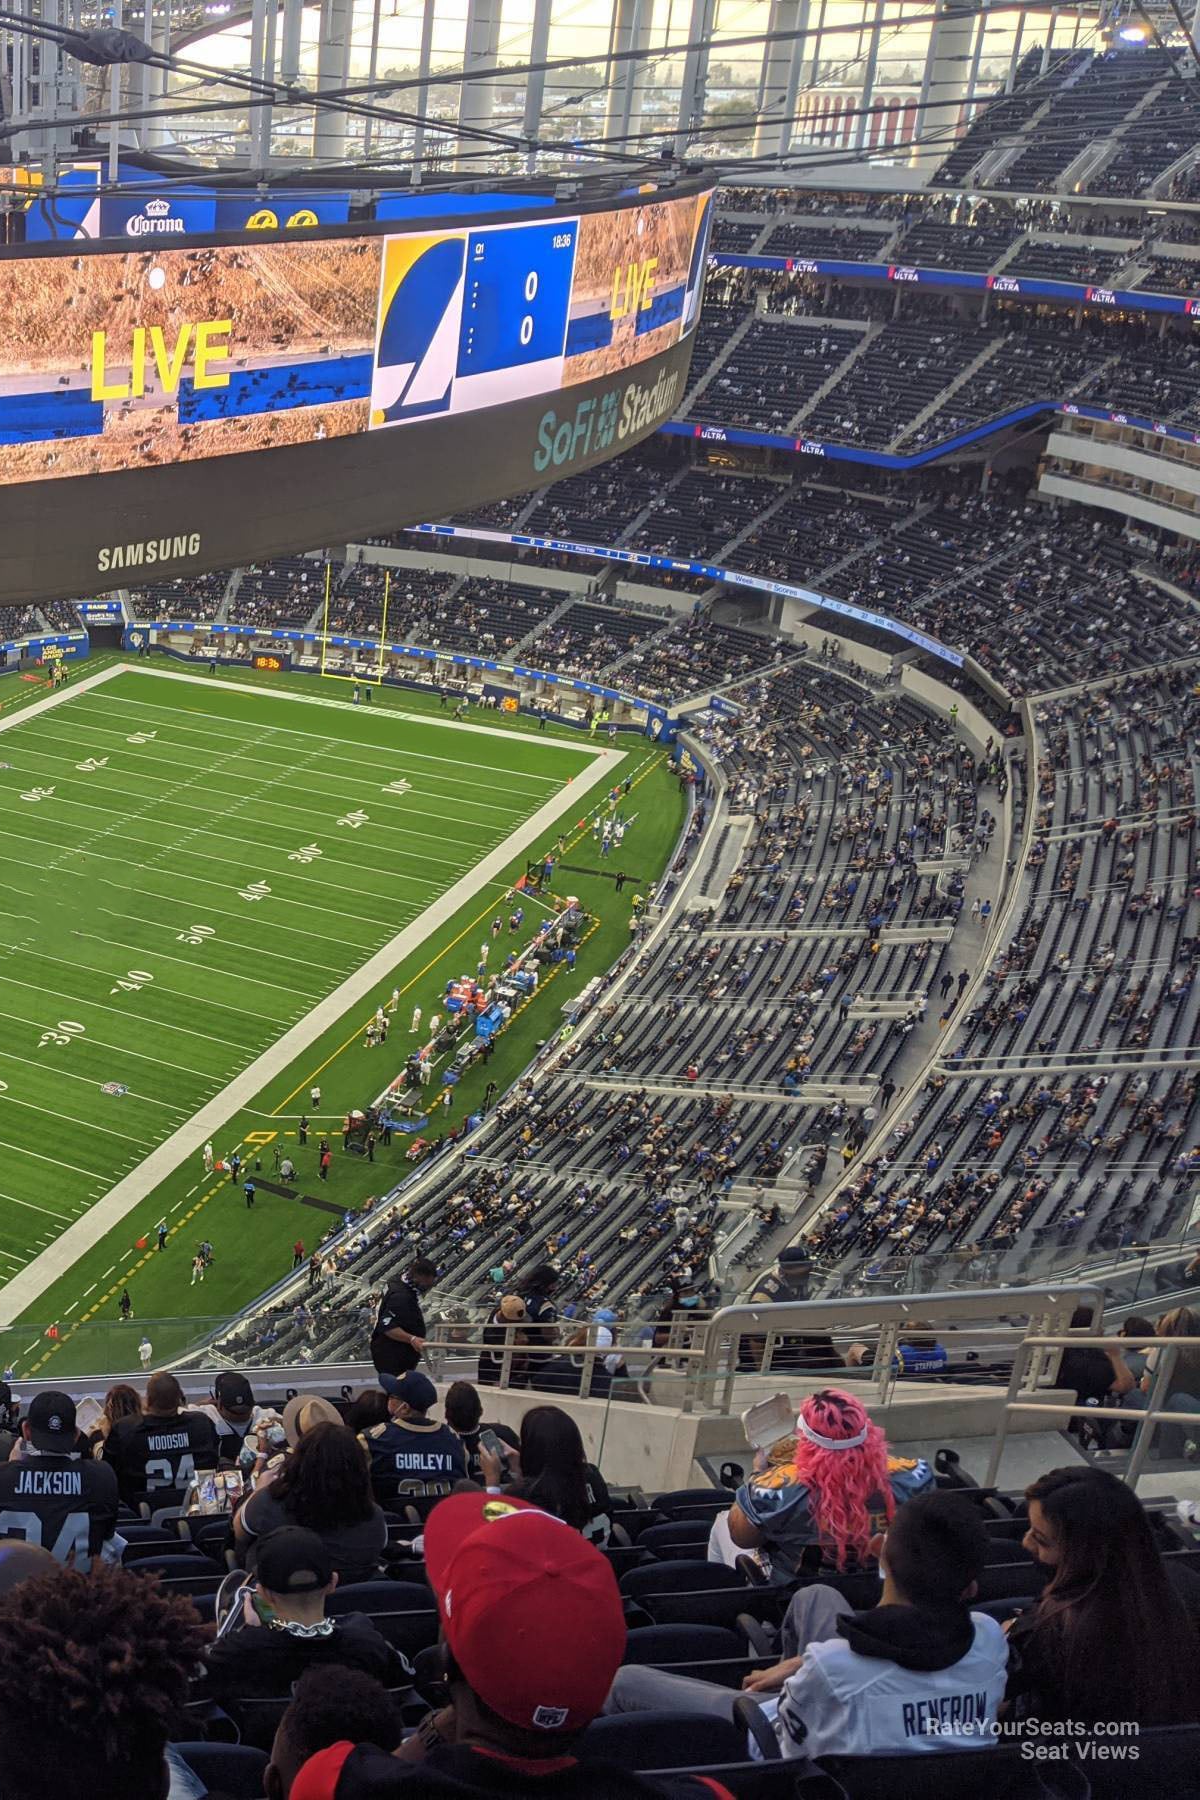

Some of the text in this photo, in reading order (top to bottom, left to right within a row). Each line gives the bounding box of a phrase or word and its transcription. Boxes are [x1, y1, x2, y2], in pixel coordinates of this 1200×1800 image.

[126, 214, 186, 236] Corona
[552, 234, 571, 248] 18:36
[792, 264, 818, 273] ULTRA
[894, 272, 919, 282] ULTRA
[525, 271, 538, 301] 0
[610, 257, 658, 321] LIVE
[993, 281, 1020, 293] ULTRA
[1091, 293, 1116, 305] ULTRA
[520, 315, 533, 345] 0
[91, 319, 232, 401] LIVE
[533, 366, 678, 472] SoFi Stadium
[701, 431, 727, 441] ULTRA
[801, 445, 825, 456] ULTRA
[97, 533, 201, 572] SAMSUNG
[774, 584, 798, 597] Scores
[914, 1359, 944, 1373] STAFFORD
[147, 1432, 190, 1451] WOODSON
[395, 1453, 443, 1471] GURLEY
[445, 1453, 453, 1471] II
[14, 1470, 82, 1496] JACKSON
[902, 1691, 988, 1738] RENFROW
